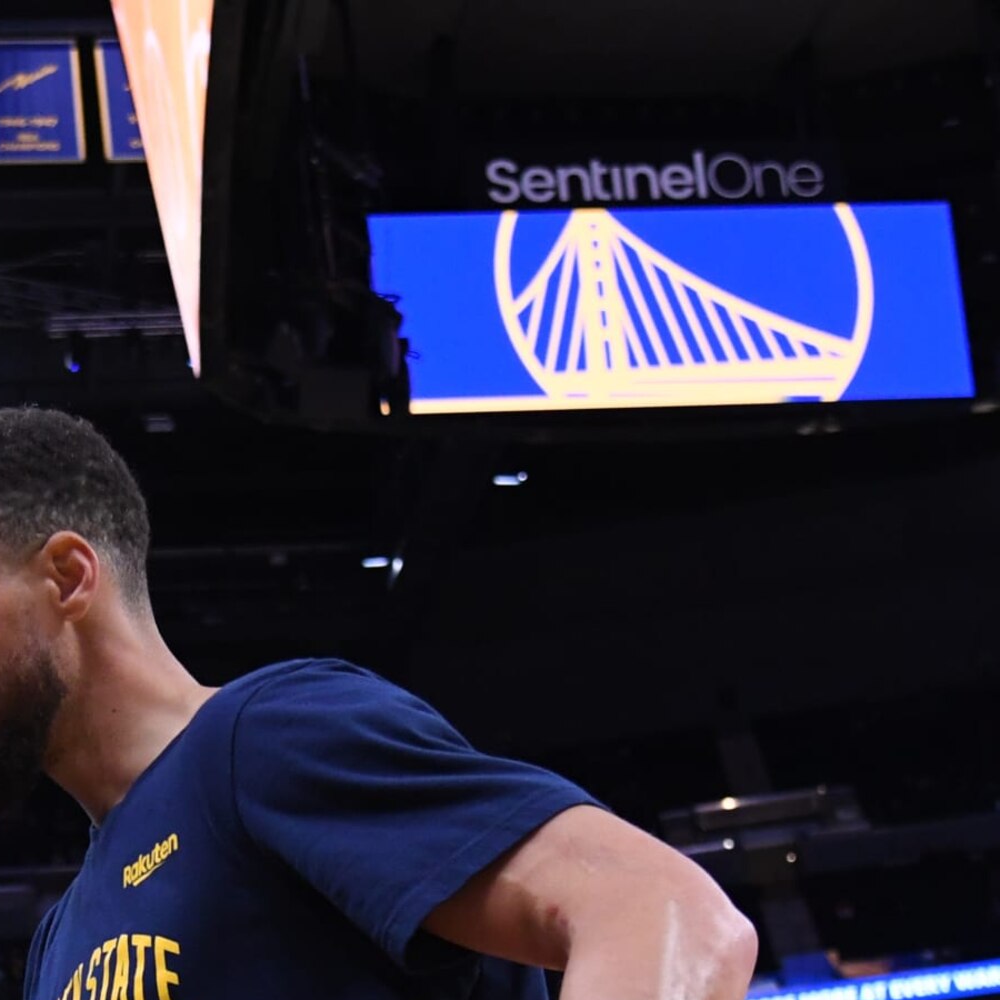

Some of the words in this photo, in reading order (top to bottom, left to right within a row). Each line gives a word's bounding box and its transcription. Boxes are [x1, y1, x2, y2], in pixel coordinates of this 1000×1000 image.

[486, 150, 824, 203] SentinelOne
[123, 833, 178, 888] Rakuten
[888, 972, 951, 1000] EVERY
